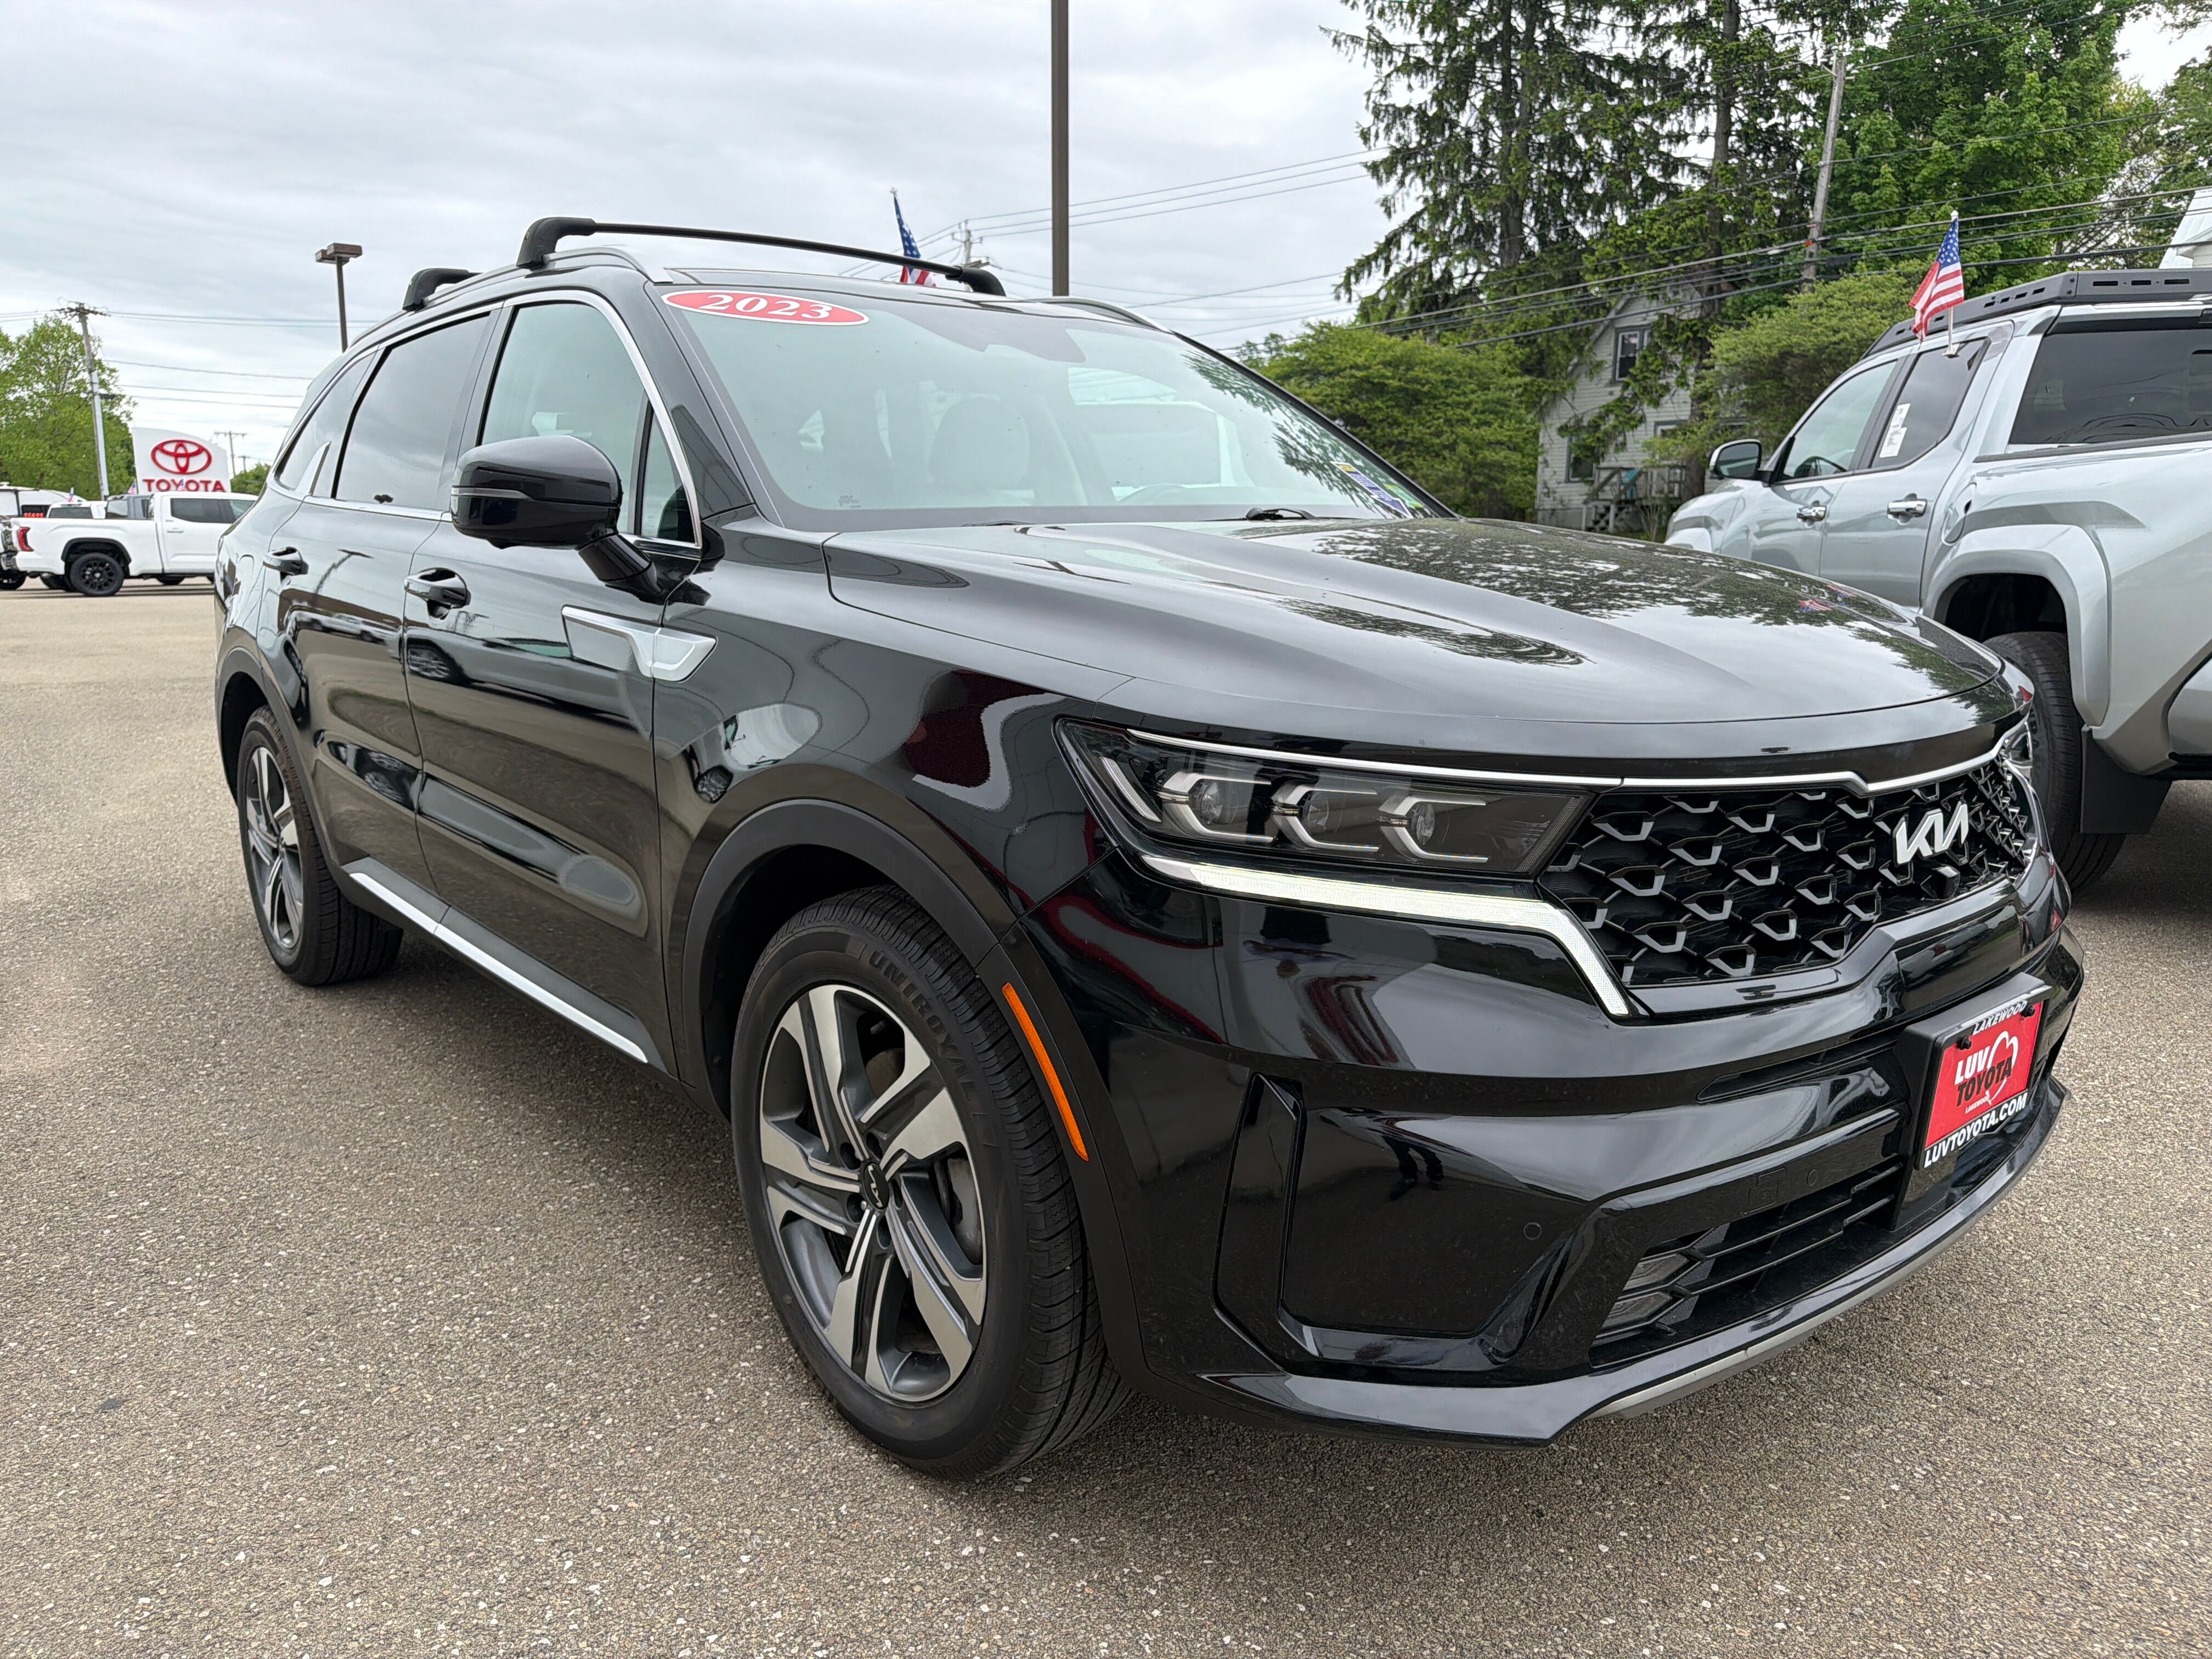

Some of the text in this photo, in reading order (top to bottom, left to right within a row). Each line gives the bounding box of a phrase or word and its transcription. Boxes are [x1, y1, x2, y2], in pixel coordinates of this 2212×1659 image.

[698, 295, 833, 319] 2023
[143, 479, 226, 492] TOYOTA
[869, 950, 975, 1101] UNIROYAL
[1972, 1001, 2028, 1036] LAKEWOOD
[1954, 1046, 1990, 1085] LUV
[1956, 1057, 2012, 1107] TOYOTA
[1965, 1095, 1990, 1114] LAKEWOOD
[1924, 1092, 2028, 1168] LUVTOYOTA.COM
